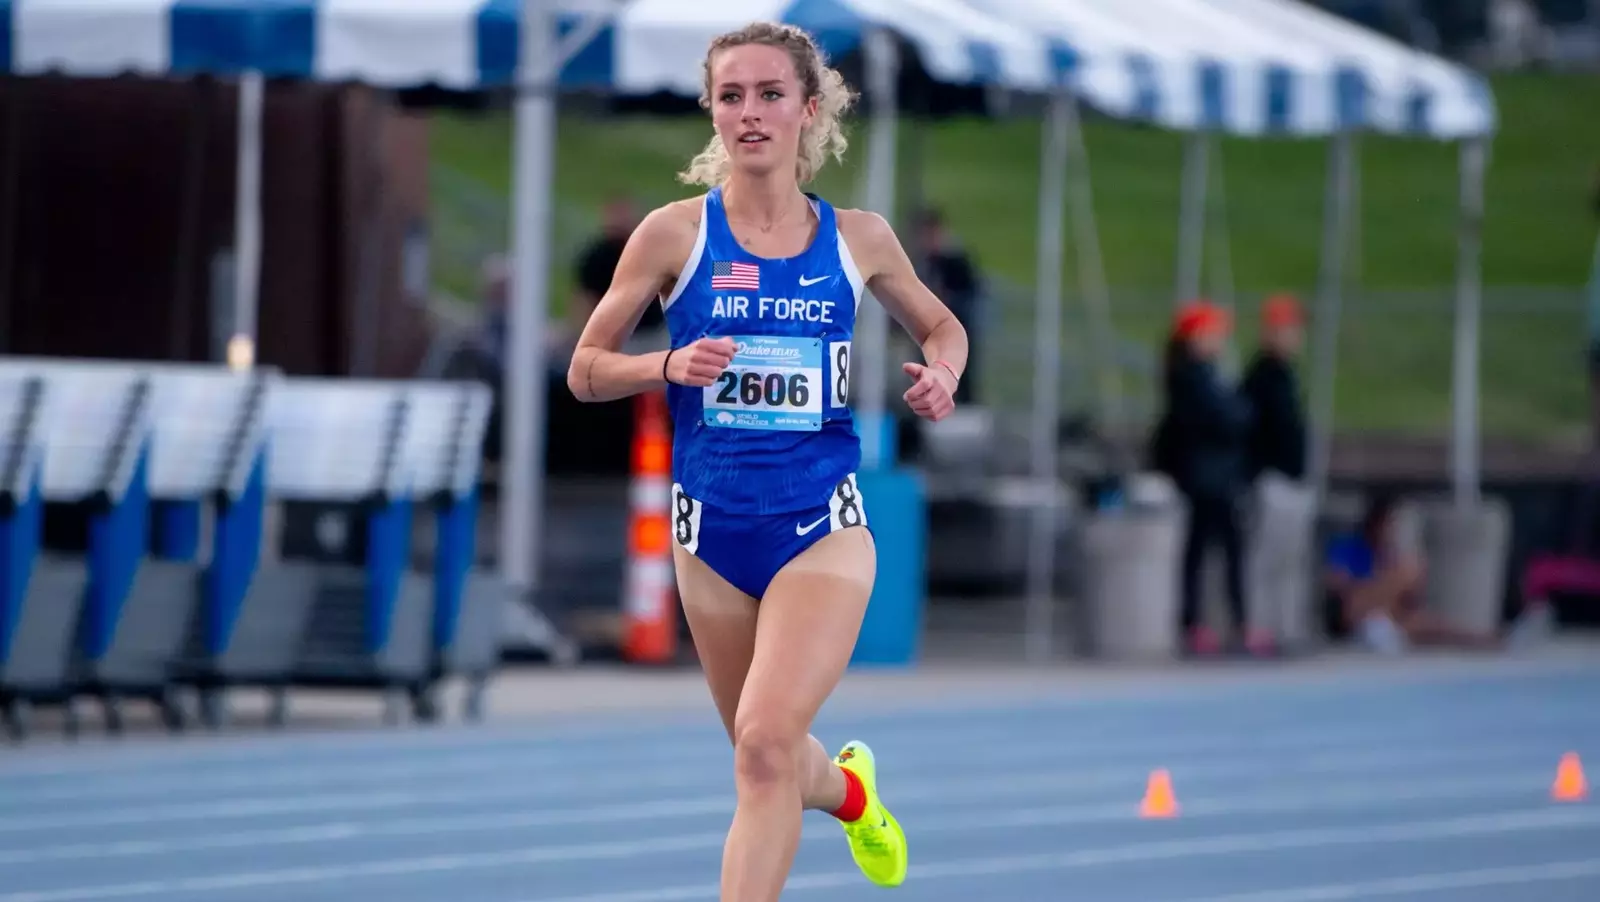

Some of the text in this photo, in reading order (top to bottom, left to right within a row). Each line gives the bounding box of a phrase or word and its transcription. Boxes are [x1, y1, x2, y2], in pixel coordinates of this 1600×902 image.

[712, 296, 835, 323] AIR FORCE
[771, 347, 800, 357] RELAYS
[716, 371, 809, 407] 2606
[837, 345, 848, 404] 8
[677, 492, 693, 545] 8
[837, 477, 861, 528] 8
